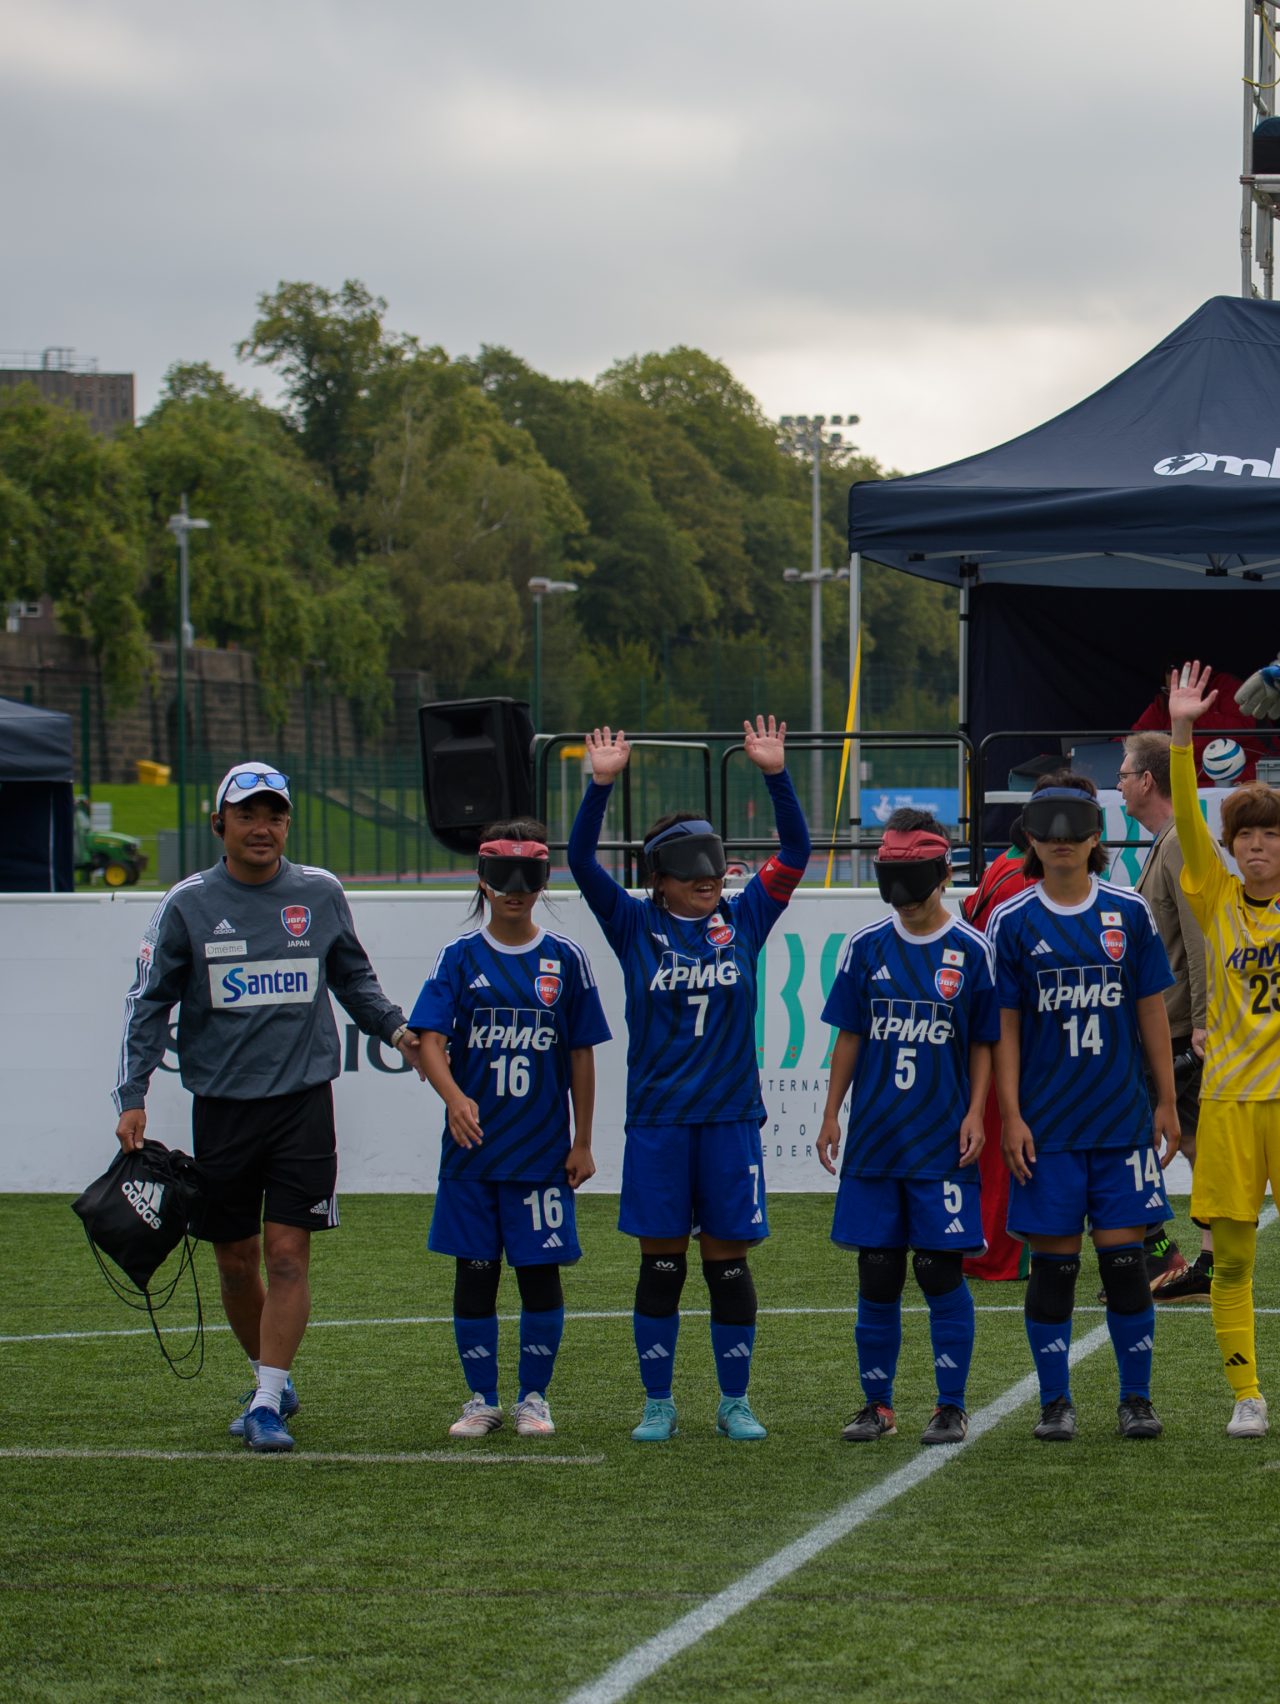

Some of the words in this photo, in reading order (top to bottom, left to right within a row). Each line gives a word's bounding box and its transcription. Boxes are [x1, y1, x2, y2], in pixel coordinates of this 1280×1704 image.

[287, 940, 310, 948] JAPAN
[222, 967, 308, 1003] Santen
[650, 961, 738, 991] KPMG
[687, 995, 710, 1037] 7
[1038, 983, 1123, 1012] KPMG
[467, 1025, 557, 1051] KPMG
[869, 1016, 952, 1044] KPMG
[1063, 1015, 1104, 1057] 14
[490, 1055, 530, 1098] 16
[894, 1048, 917, 1090] 5
[749, 1165, 759, 1205] 7
[1125, 1148, 1161, 1191] 14
[121, 1180, 162, 1231] adidas
[523, 1187, 564, 1231] 16
[943, 1181, 963, 1214] 5
